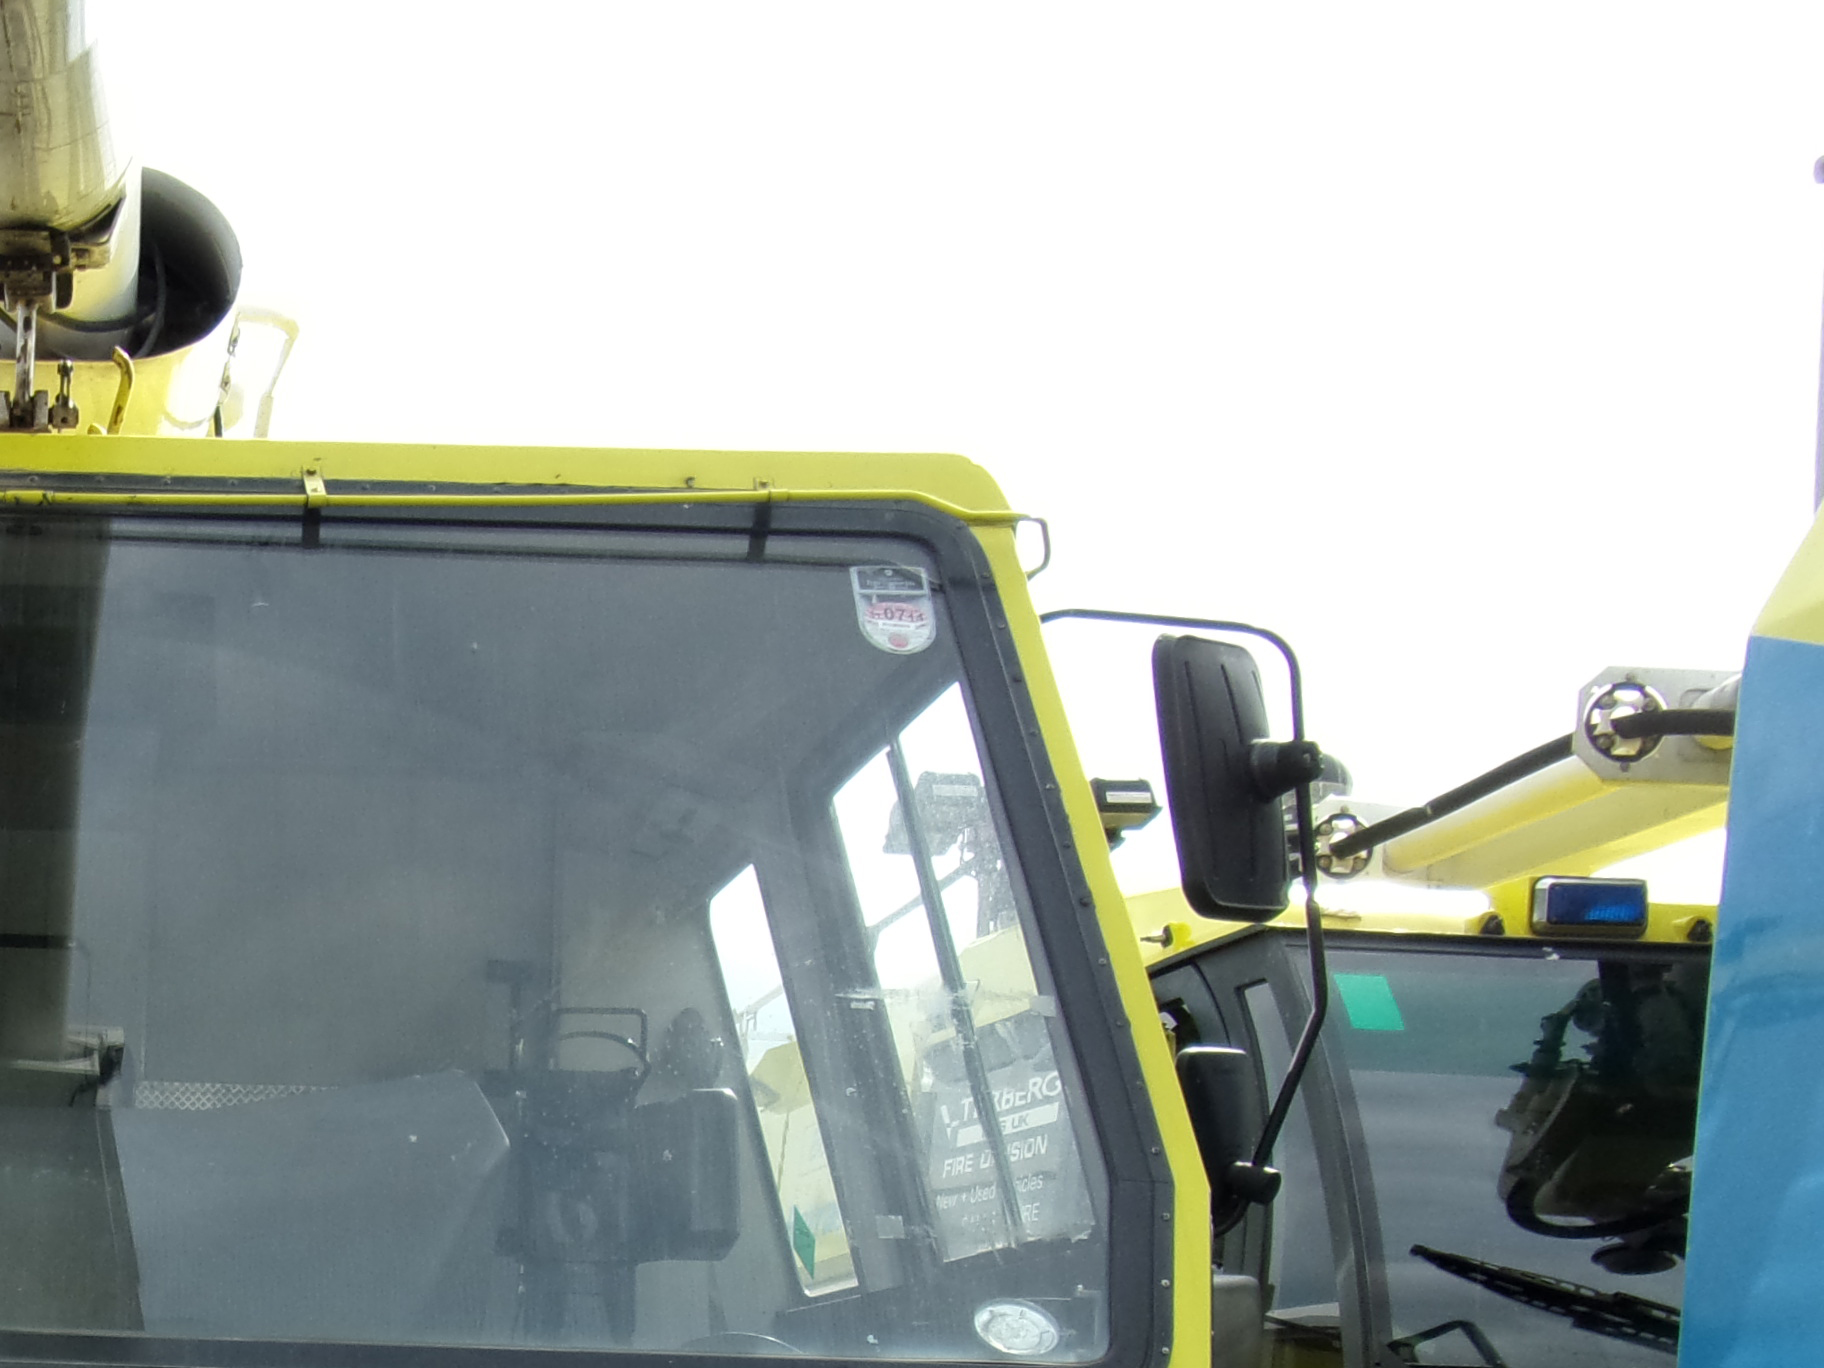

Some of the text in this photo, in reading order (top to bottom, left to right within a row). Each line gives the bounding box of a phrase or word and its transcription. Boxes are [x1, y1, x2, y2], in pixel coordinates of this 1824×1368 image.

[961, 1070, 1062, 1121] TRBERG
[942, 1153, 974, 1179] FIRE
[970, 1182, 997, 1204] Used
